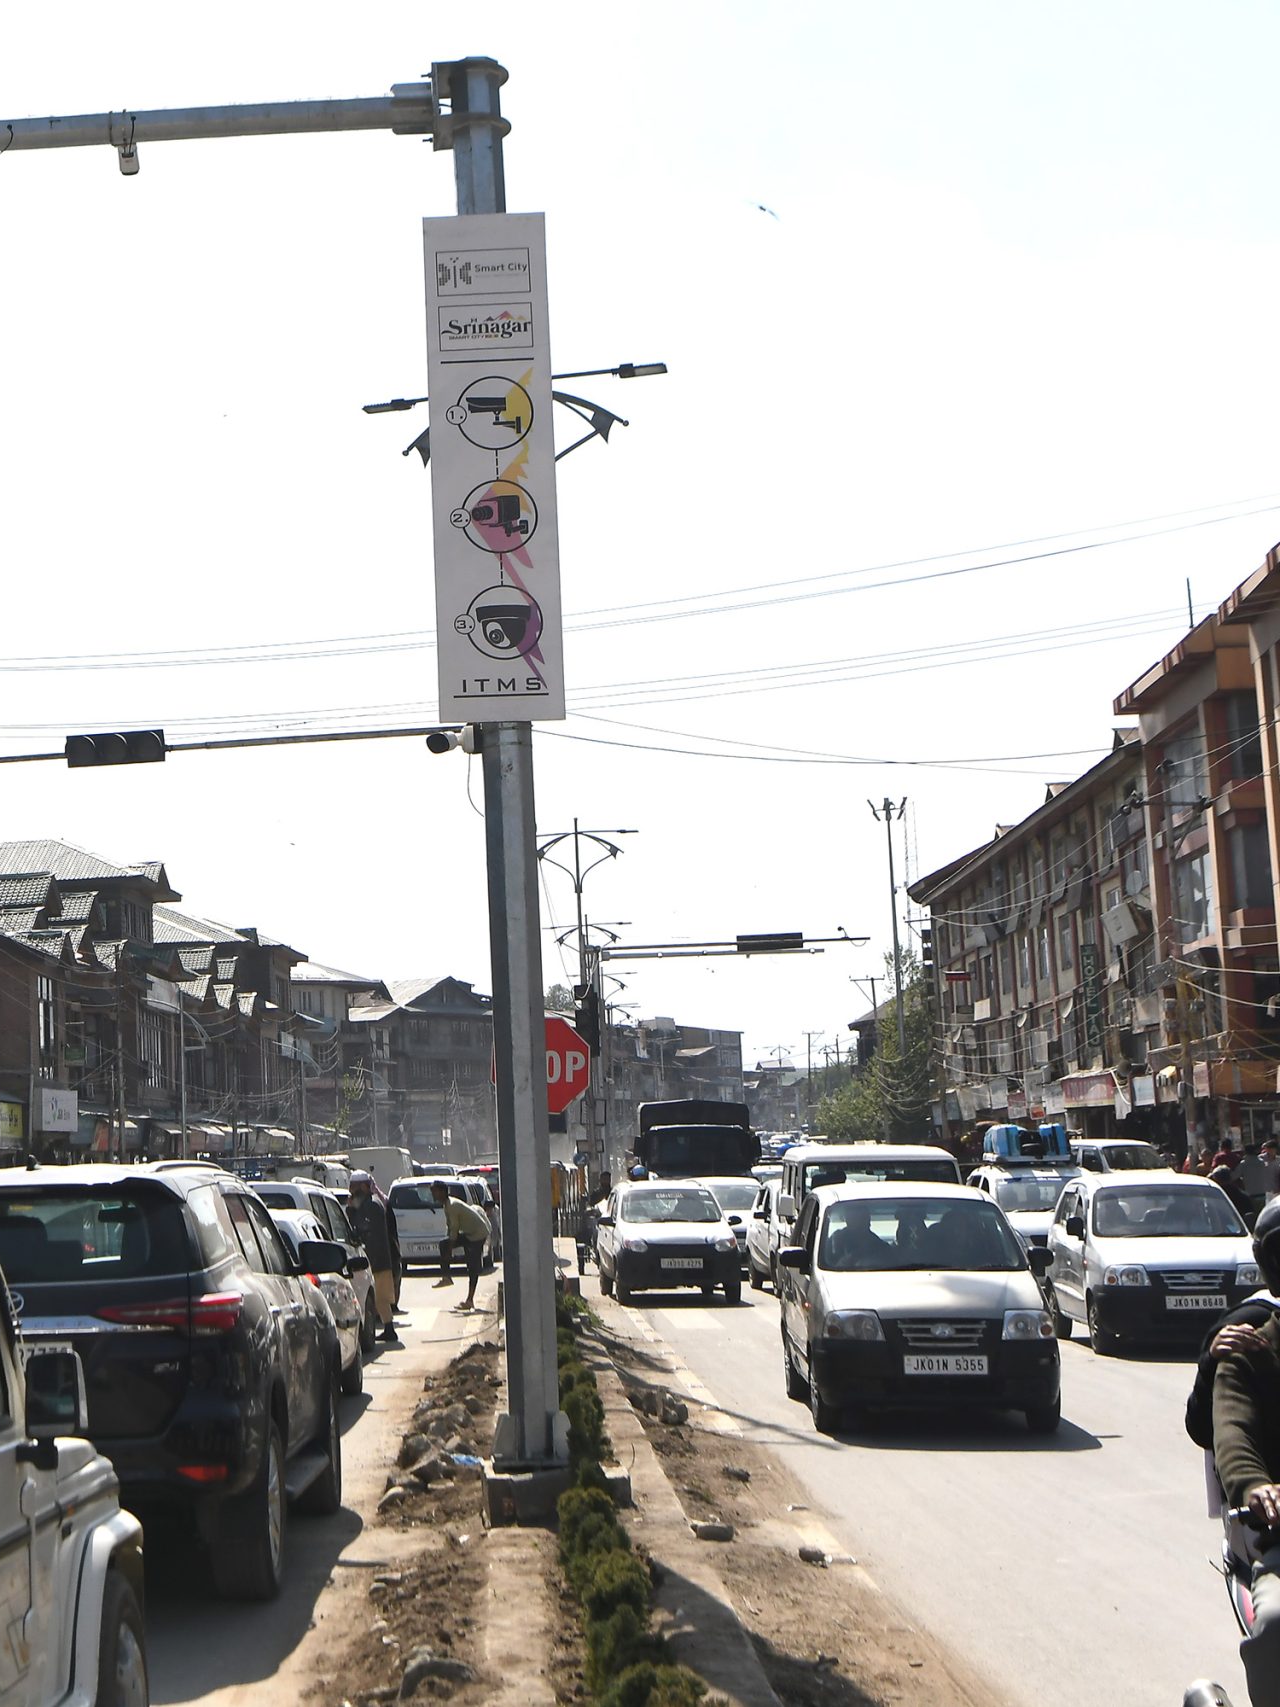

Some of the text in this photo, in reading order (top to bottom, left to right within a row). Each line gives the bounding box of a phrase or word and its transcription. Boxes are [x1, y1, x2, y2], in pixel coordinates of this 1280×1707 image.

[474, 261, 528, 273] Smart City
[441, 317, 532, 339] Srinagar
[453, 513, 469, 523] 2.
[456, 619, 473, 629] 3.
[461, 677, 543, 693] ITMS
[545, 1050, 586, 1084] OP
[913, 1358, 985, 1372] JK01N 5355
